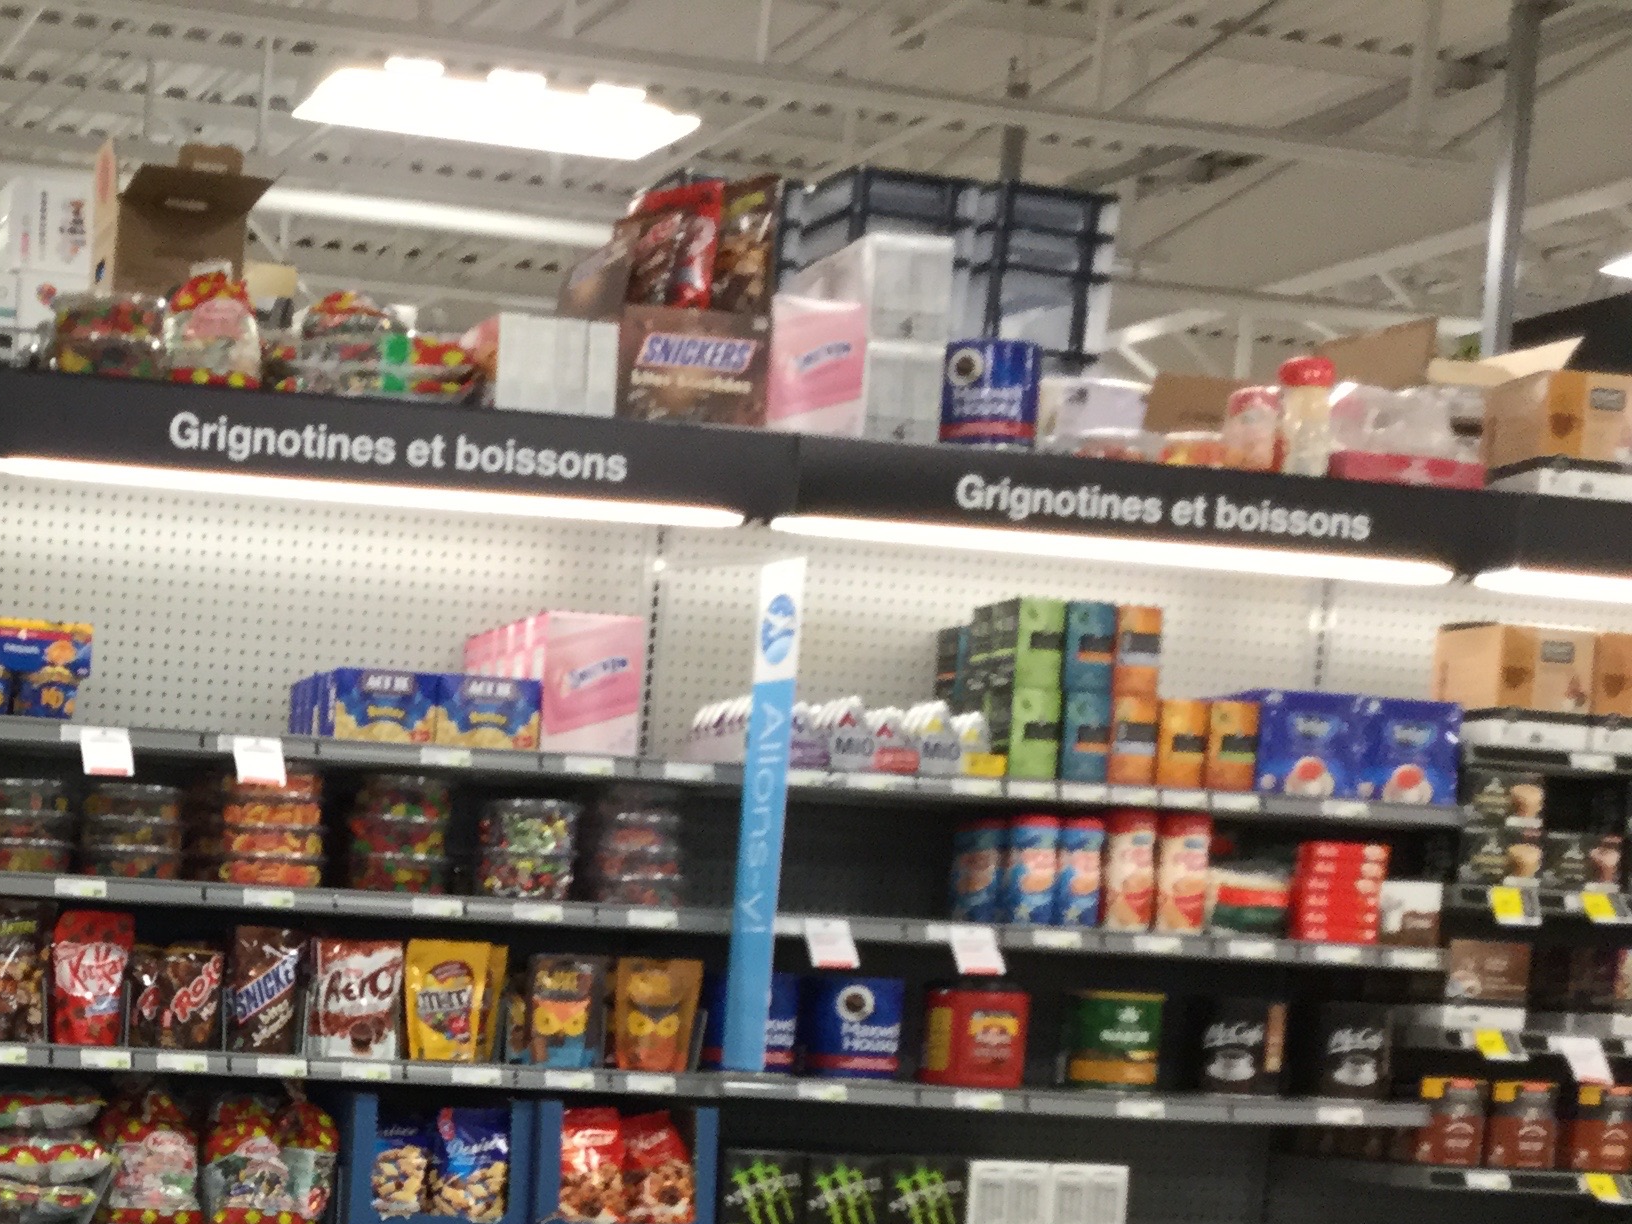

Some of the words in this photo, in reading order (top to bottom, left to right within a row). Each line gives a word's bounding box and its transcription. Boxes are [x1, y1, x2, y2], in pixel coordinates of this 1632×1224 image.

[168, 411, 396, 466] Grignotines
[406, 433, 446, 469] et
[454, 435, 628, 483] boissons
[955, 473, 1164, 523] Grignotines
[1170, 497, 1206, 529] et
[1213, 498, 1371, 543] boissons
